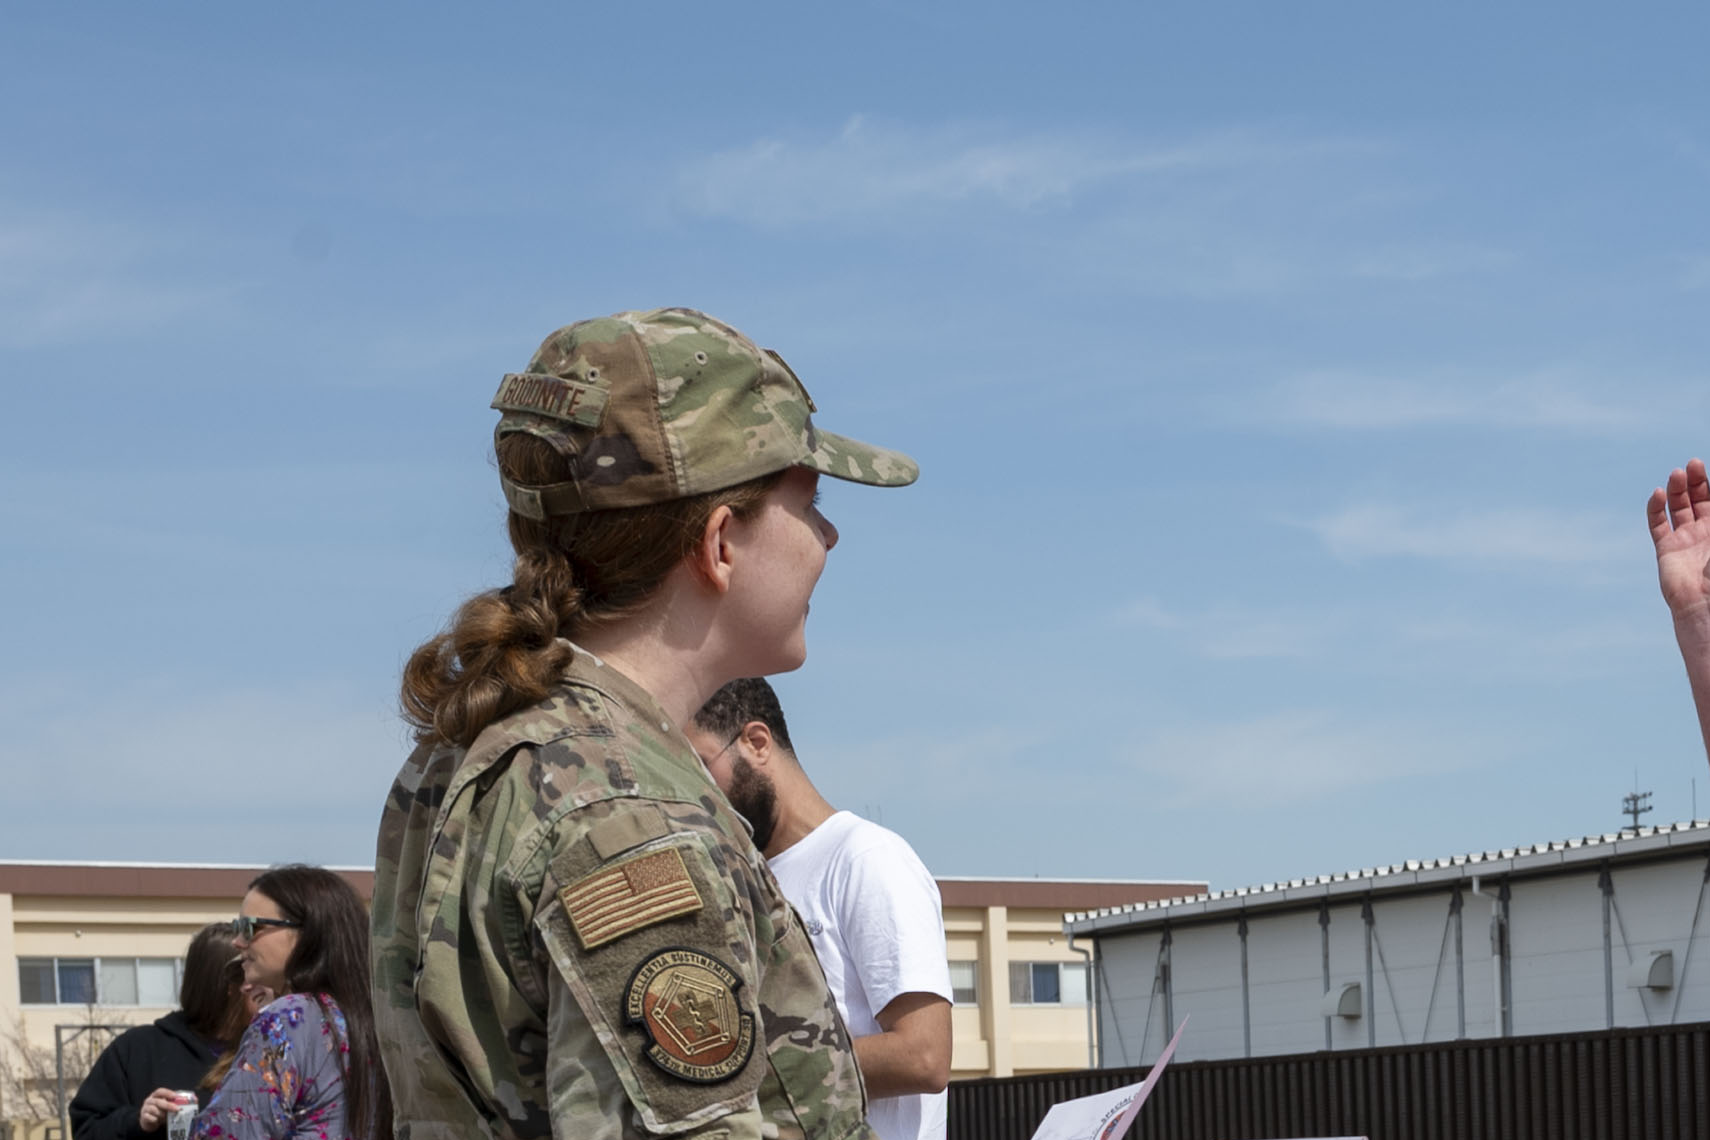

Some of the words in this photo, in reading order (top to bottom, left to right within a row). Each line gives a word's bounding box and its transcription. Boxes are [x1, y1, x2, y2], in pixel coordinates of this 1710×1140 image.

[502, 376, 585, 416] GOODNITE
[631, 957, 670, 1017] EXCELLENTIA
[682, 1062, 726, 1078] MEDICAL
